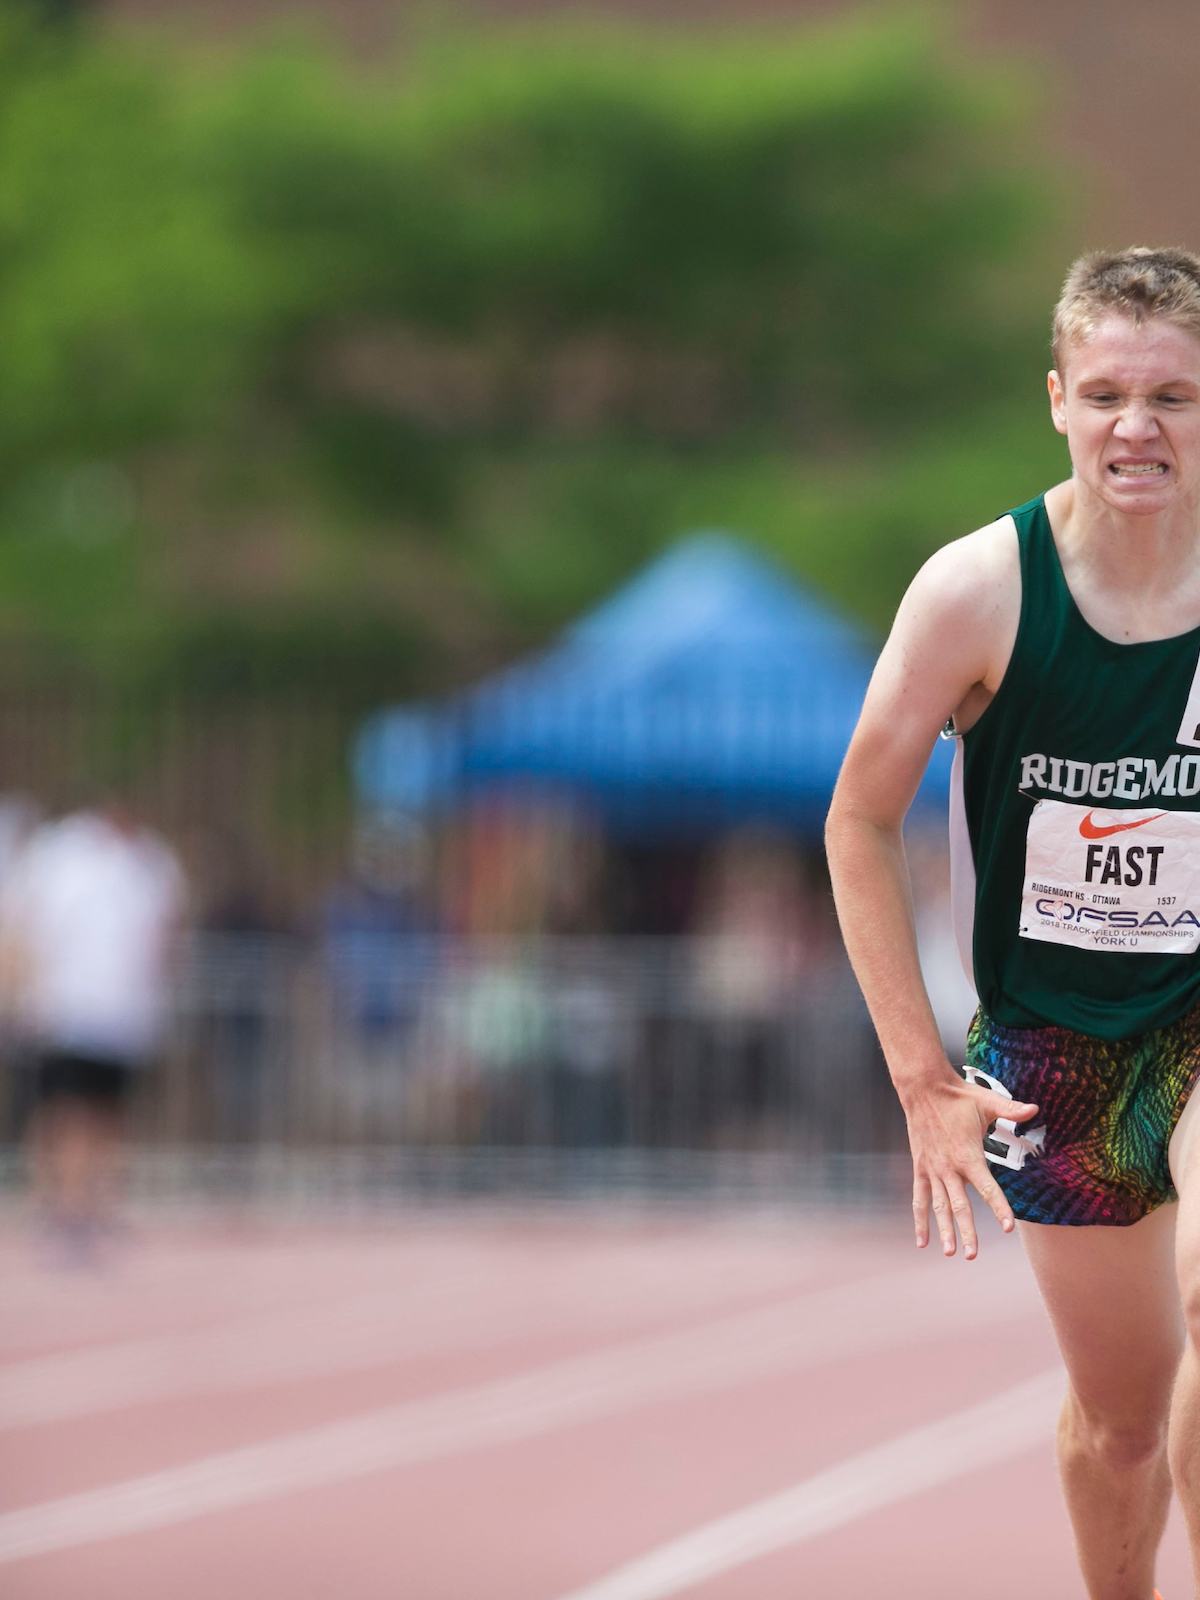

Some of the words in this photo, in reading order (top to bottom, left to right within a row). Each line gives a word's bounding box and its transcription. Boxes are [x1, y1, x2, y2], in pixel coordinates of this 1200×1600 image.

[1084, 844, 1164, 887] FAST
[1031, 883, 1073, 898] RIDGEMONT
[1075, 892, 1085, 901] HS
[1092, 895, 1121, 906] OTTAWA
[1156, 897, 1177, 906] 1537
[1040, 918, 1061, 929] 2018
[1121, 929, 1194, 938] CHAMPIONSHIPS
[1093, 936, 1126, 946] YORK
[1130, 937, 1138, 946] U
